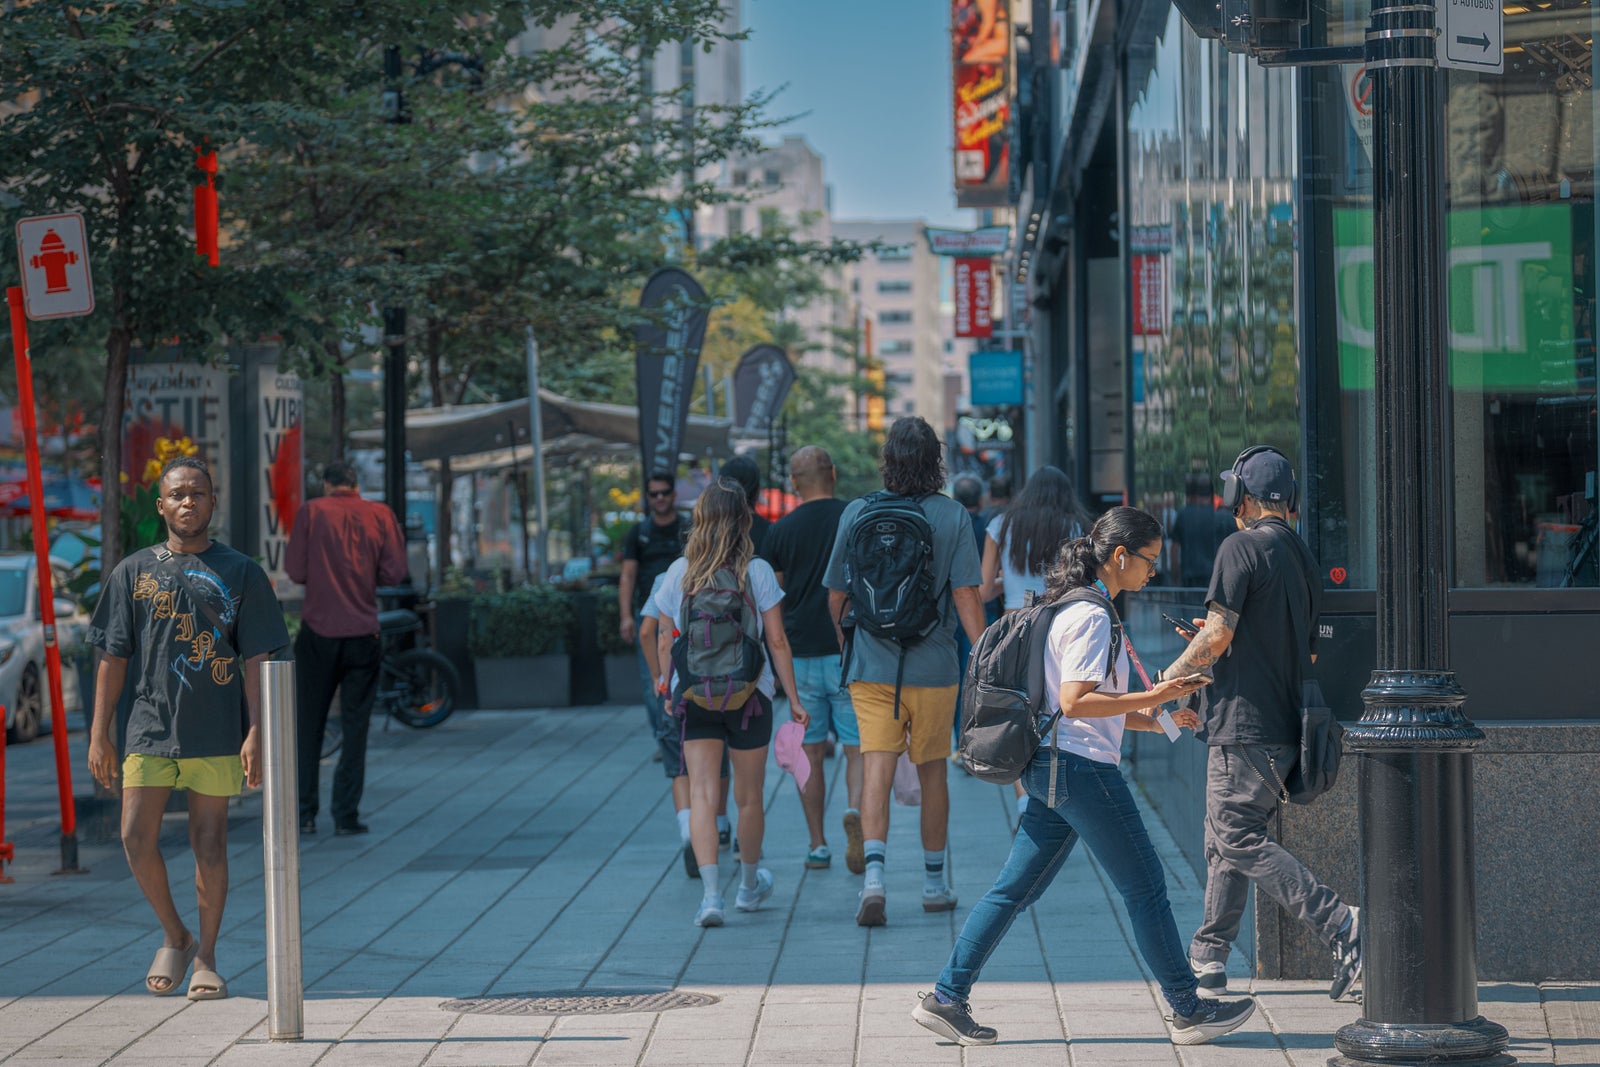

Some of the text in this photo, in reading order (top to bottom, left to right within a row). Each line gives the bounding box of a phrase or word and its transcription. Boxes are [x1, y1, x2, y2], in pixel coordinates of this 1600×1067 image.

[957, 264, 971, 333] BEIGNETS
[975, 308, 990, 327] ET
[651, 308, 684, 474] IVERSEL
[133, 572, 235, 685] SAINT
